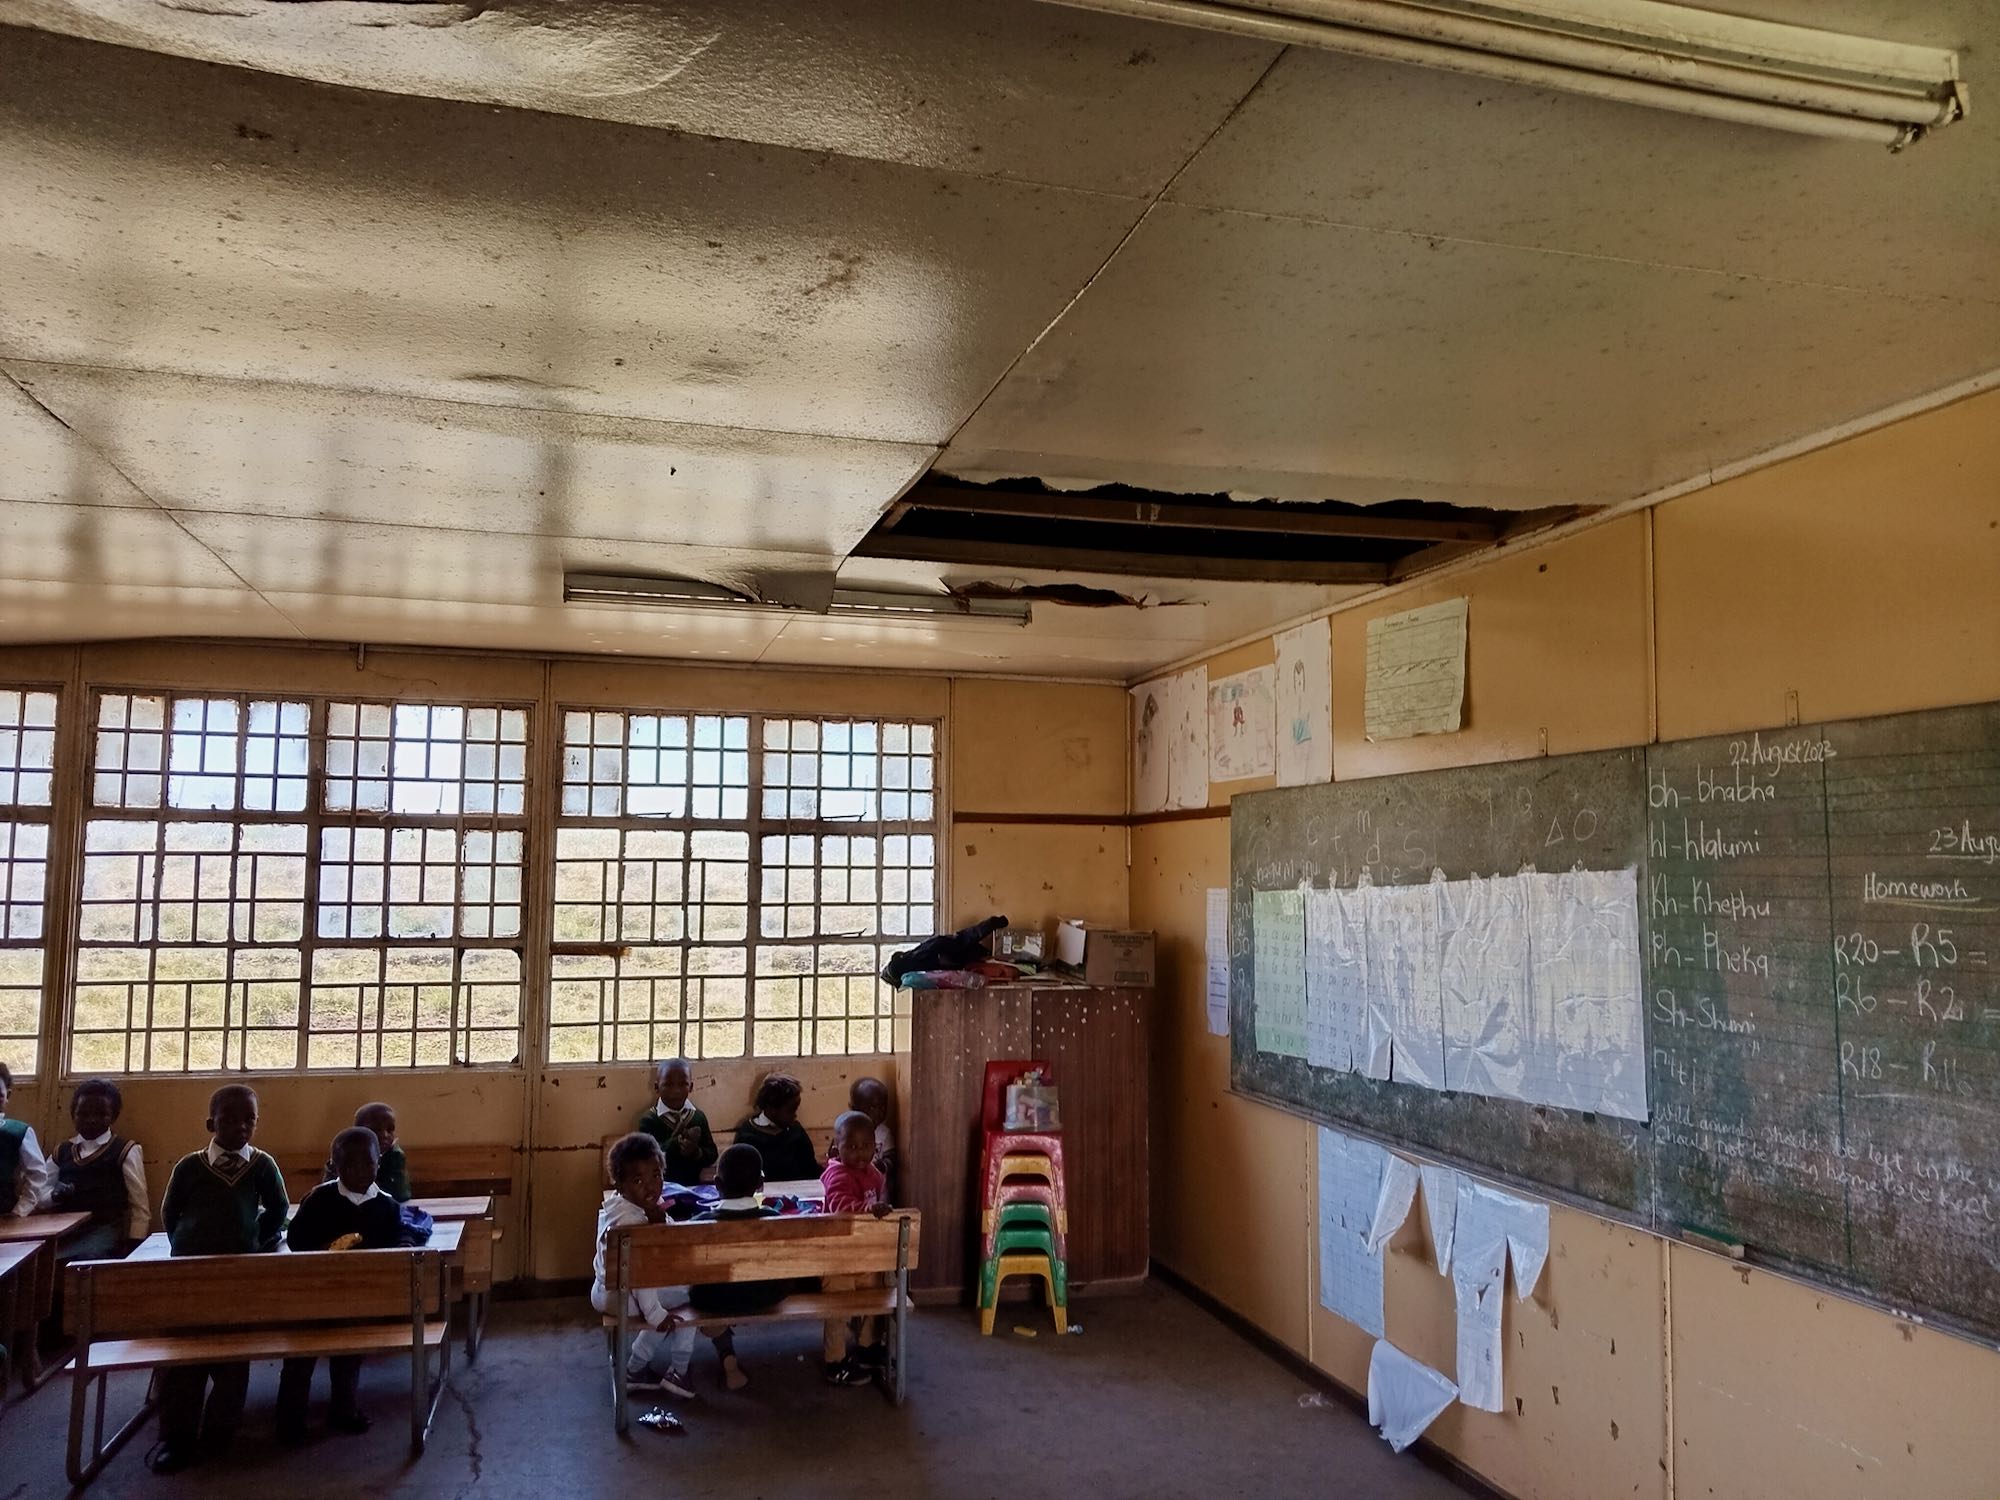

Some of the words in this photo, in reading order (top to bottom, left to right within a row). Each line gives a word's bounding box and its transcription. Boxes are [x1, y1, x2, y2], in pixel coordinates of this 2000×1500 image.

[1929, 827, 1959, 852] 23
[1864, 871, 1968, 902] Homework
[1834, 932, 1878, 967] R20
[1911, 921, 1957, 969] R5
[1836, 972, 1877, 1017] R6
[1840, 1041, 1882, 1081] R18
